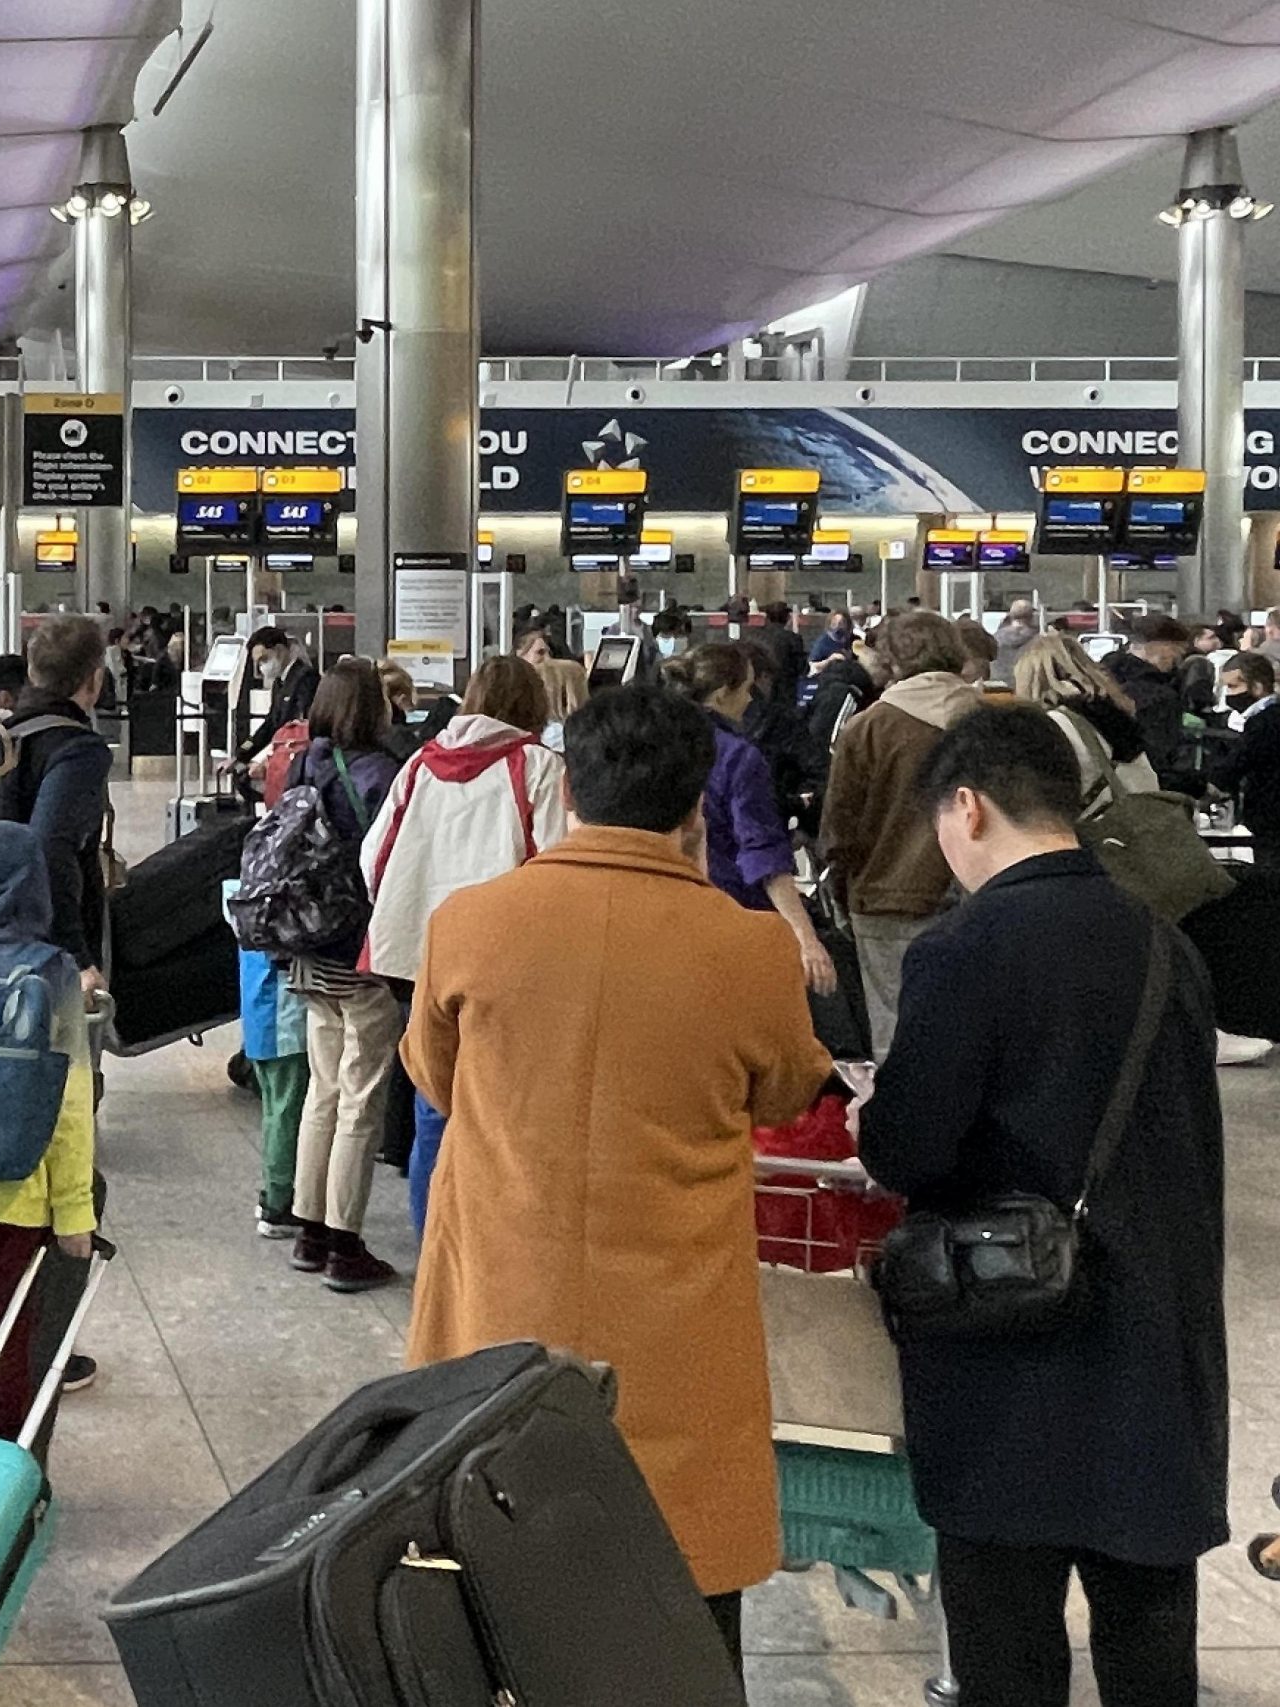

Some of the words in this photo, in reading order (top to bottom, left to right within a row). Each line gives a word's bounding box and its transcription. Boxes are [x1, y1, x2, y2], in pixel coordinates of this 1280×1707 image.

[54, 398, 82, 408] Zone
[180, 431, 357, 455] CONNEC
[479, 431, 527, 455] OU
[1022, 431, 1274, 455] CONNECG
[195, 505, 224, 519] SAS
[279, 505, 308, 519] SAS
